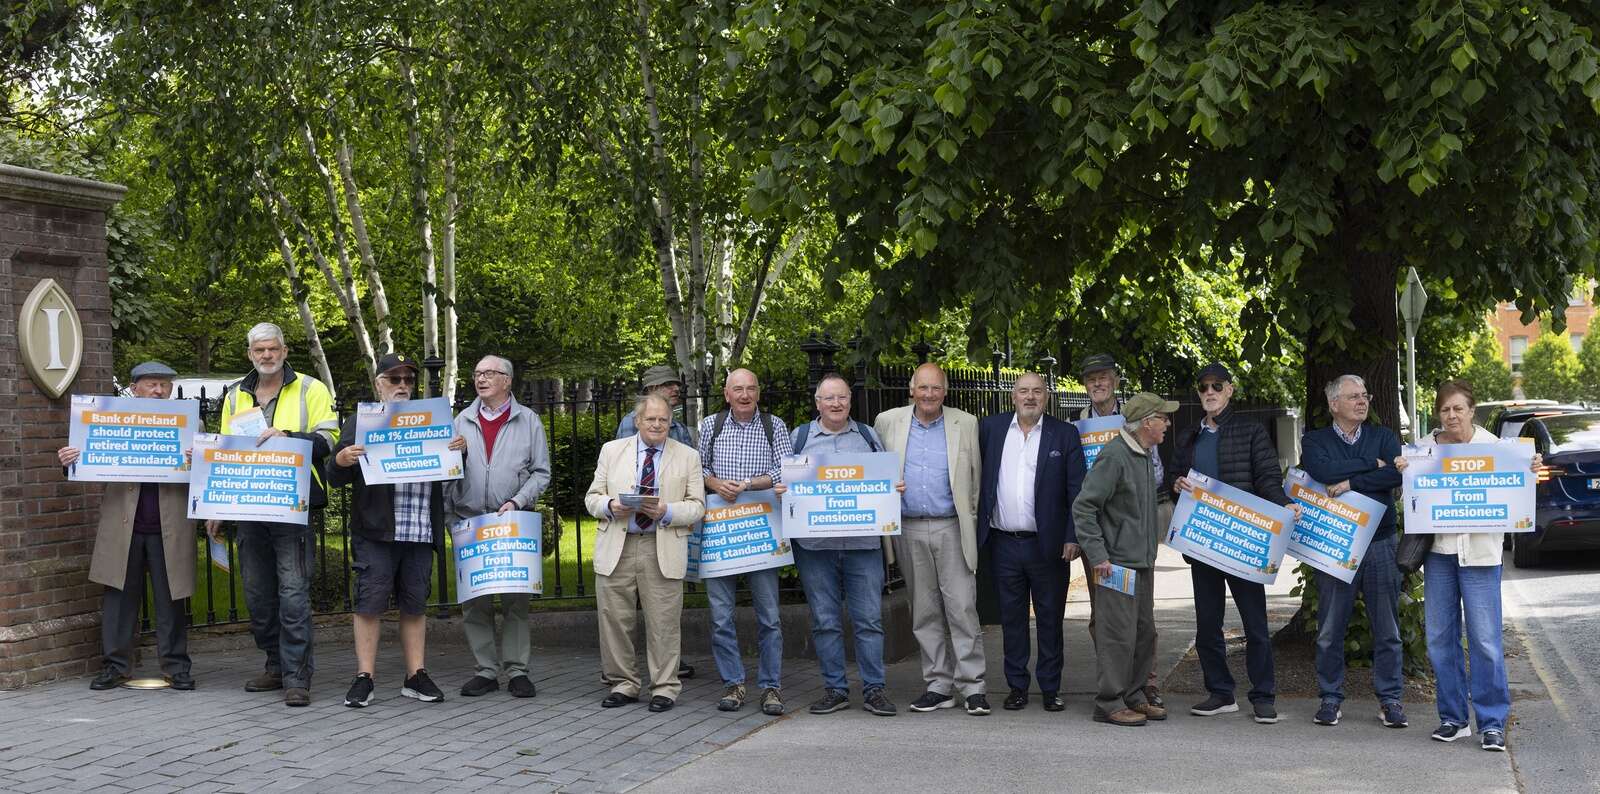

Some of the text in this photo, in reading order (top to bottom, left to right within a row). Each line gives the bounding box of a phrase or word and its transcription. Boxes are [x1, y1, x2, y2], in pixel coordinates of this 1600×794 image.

[91, 413, 177, 425] Bank of Ireland
[397, 415, 426, 426] STOP
[93, 427, 175, 440] should protect
[369, 427, 450, 442] the 1% clawback
[90, 440, 177, 452] retired workers
[397, 444, 421, 454] from
[88, 453, 178, 465] living standards
[214, 452, 296, 464] Bank of Ireland
[214, 465, 293, 478] should protect
[384, 458, 439, 472] pensioners
[1450, 460, 1486, 471] STOP
[825, 468, 856, 479] STOP
[211, 478, 294, 490] retired workers
[1418, 474, 1520, 487] the 1% clawback
[795, 482, 887, 494] the 1% clawback
[208, 491, 294, 505] living standards
[828, 498, 855, 507] from
[1454, 491, 1484, 501] from
[1201, 491, 1273, 530] Bank of Ireland
[1297, 488, 1360, 521] Bank of Ireland
[716, 509, 727, 519] of
[728, 504, 763, 517] Ireland
[811, 510, 873, 525] pensioners
[1435, 505, 1505, 519] pensioners
[728, 517, 765, 533] protect
[1197, 506, 1267, 541] should protect
[1319, 513, 1353, 533] protect
[482, 526, 512, 538] STOP
[728, 530, 769, 543] workers
[1191, 517, 1265, 554] retired workers
[1313, 524, 1349, 546] workers
[461, 540, 536, 558] the 1% clawback
[723, 542, 773, 558] standards
[1185, 528, 1212, 548] living
[1211, 541, 1263, 566] standards
[1302, 535, 1345, 559] standards
[485, 556, 510, 565] from
[472, 568, 527, 585] pensioners
